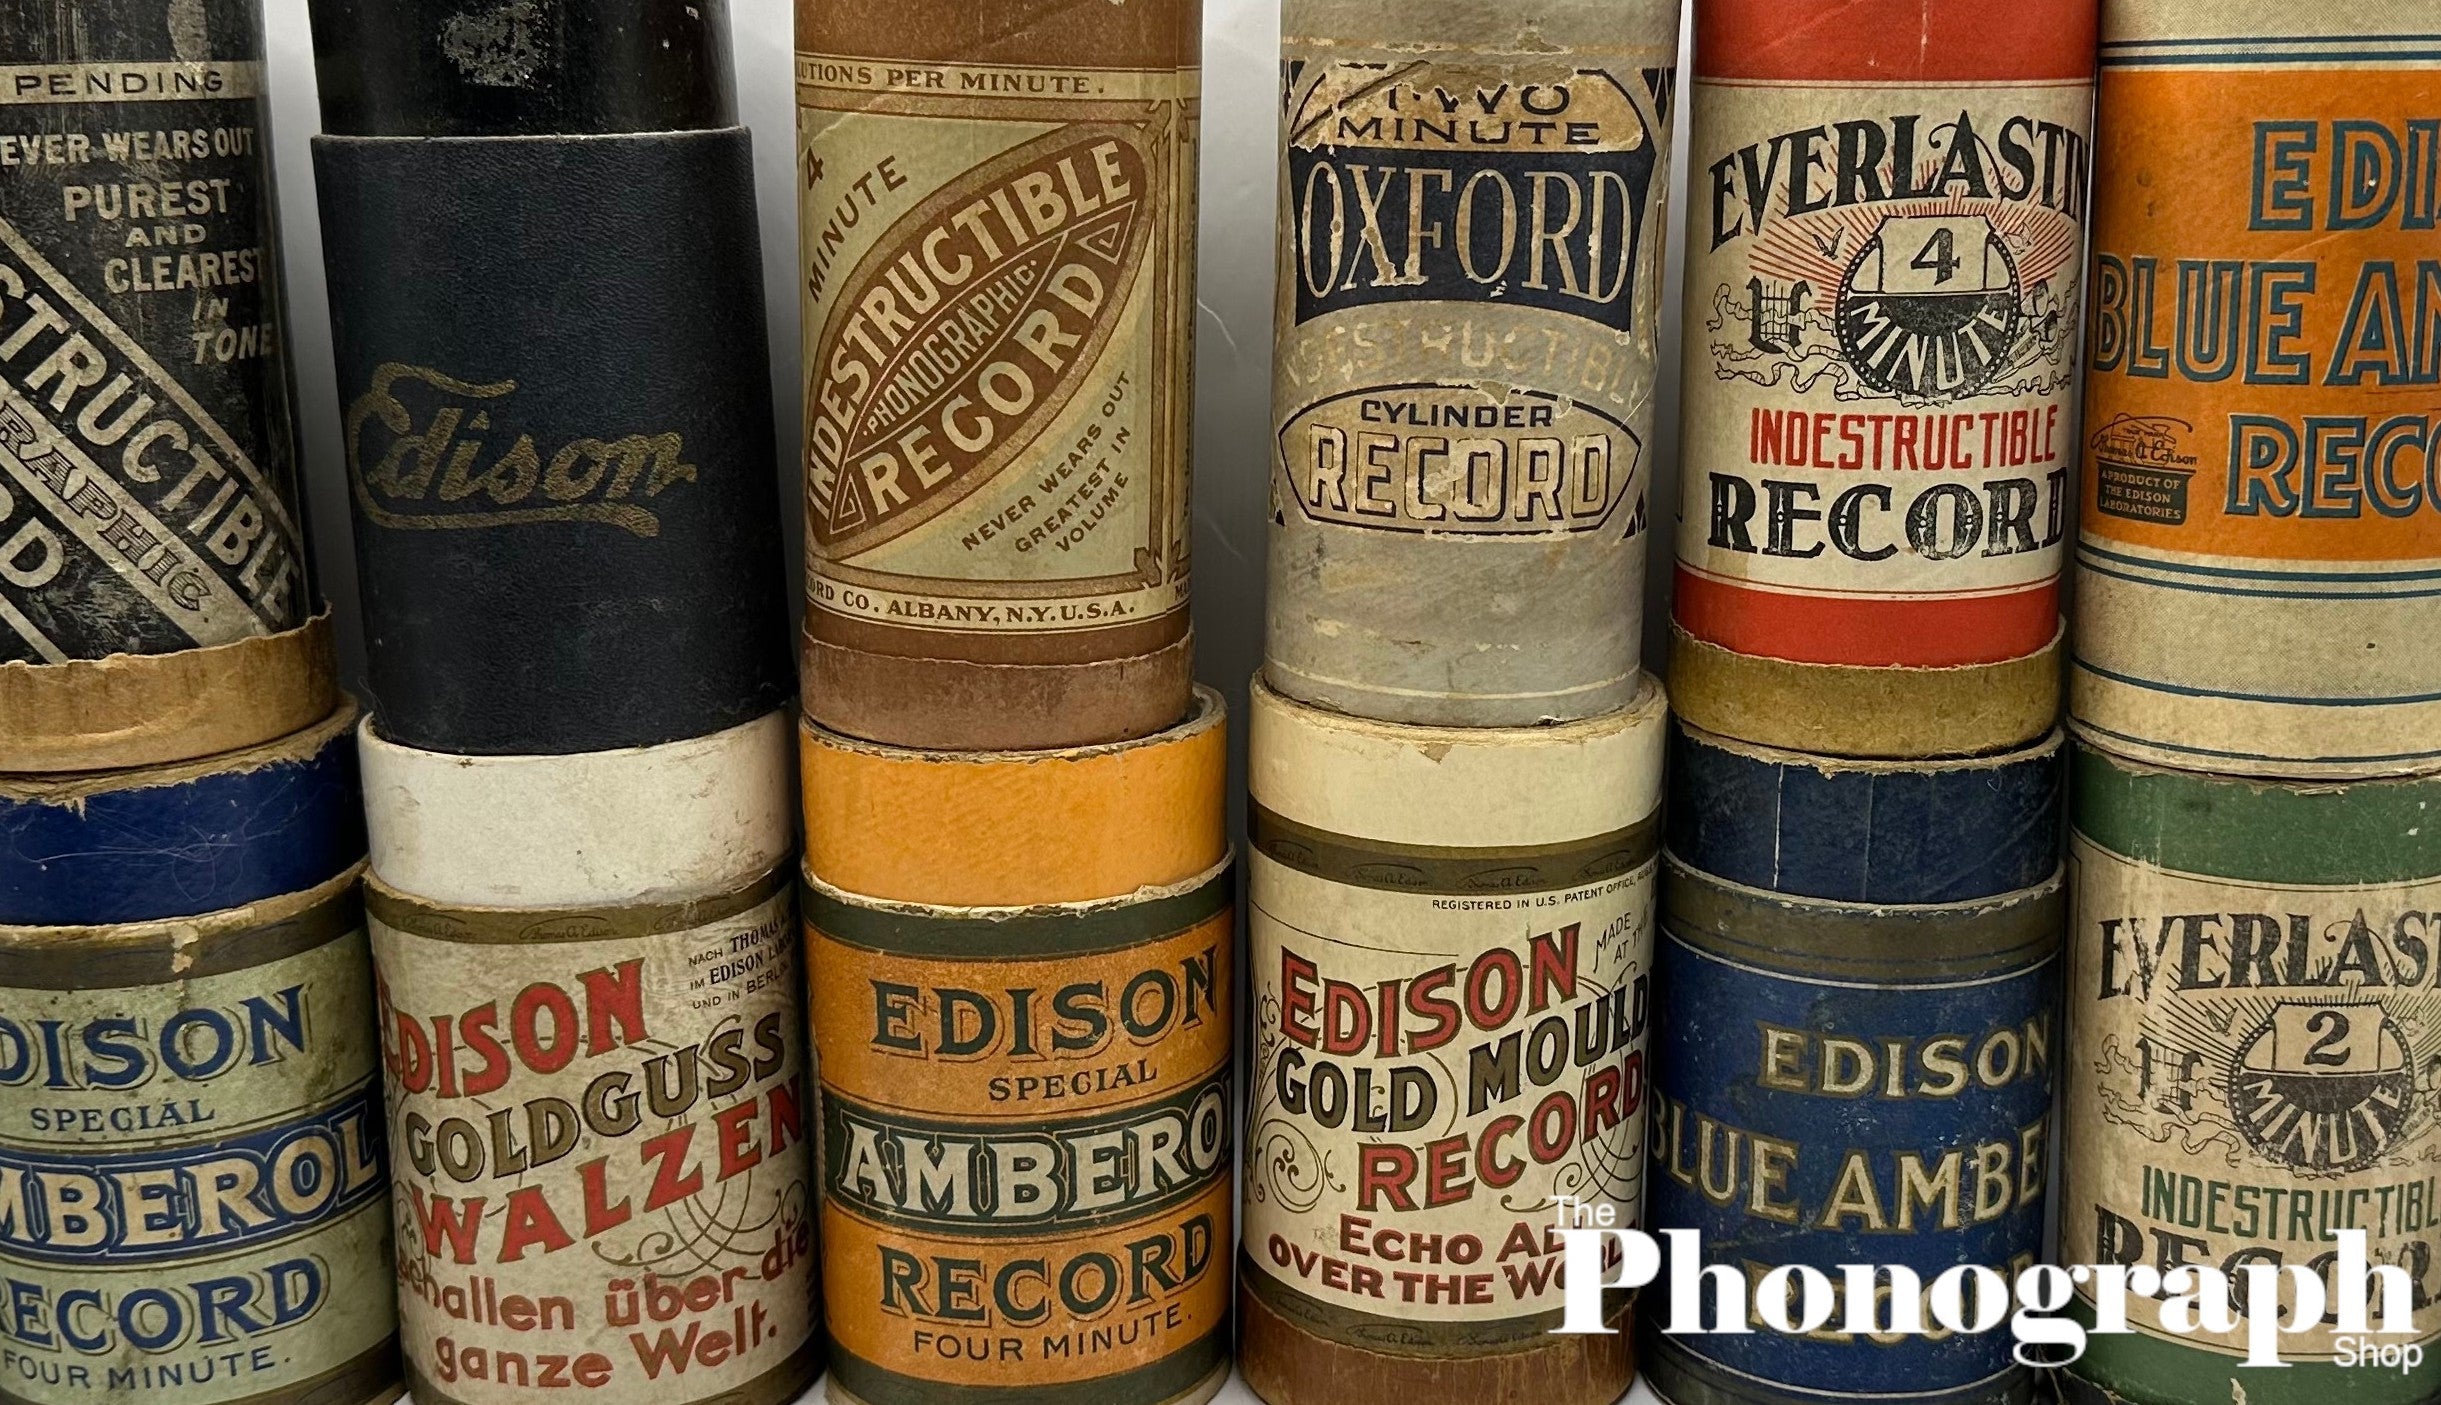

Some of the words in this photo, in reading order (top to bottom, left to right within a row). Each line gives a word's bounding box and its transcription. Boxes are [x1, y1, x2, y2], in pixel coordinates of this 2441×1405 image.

[15, 71, 223, 96] PENDING
[886, 68, 945, 89] PER
[960, 70, 1105, 95] MINUTE.
[102, 129, 209, 162] WEARS
[214, 126, 254, 157] OUT
[1337, 115, 1601, 146] MINUTE
[62, 178, 231, 222] PUREST
[806, 146, 825, 191] 4
[125, 223, 208, 248] AND
[807, 155, 909, 304] MINUTE
[1301, 159, 1633, 305] OXFORD
[1909, 227, 1960, 286] 4
[104, 247, 262, 295] CLEAREST
[193, 296, 229, 322] IN
[808, 140, 1132, 521] INDESTRUCTIBLE
[2093, 253, 2317, 385] BLUE
[193, 323, 274, 365] TONE
[1850, 300, 2008, 391] MINUTE
[861, 263, 1104, 517] RECORD
[1360, 400, 1553, 429] CYLINDER
[345, 361, 698, 538] Edison
[961, 495, 1036, 551] NEVER
[1037, 425, 1102, 494] WEARS
[1102, 370, 1132, 418] OUT
[1749, 404, 2058, 472] INDESTRUCTIBLE
[2223, 411, 2441, 519] REC
[1015, 462, 1111, 553] GREATEST
[1111, 426, 1132, 454] IN
[1308, 422, 1612, 524] RECORD
[2106, 484, 2122, 496] THE
[2125, 488, 2172, 504] EDISON
[2107, 471, 2161, 488] PRODUCT
[2163, 478, 2181, 490] OF
[1056, 473, 1130, 554] VOLUME
[1707, 466, 2068, 562] RECORD
[2100, 497, 2181, 519] LABORATORIES
[843, 590, 879, 610] CO.
[886, 600, 1001, 626] ALBANY,
[1432, 899, 1512, 911] REGISTERED
[1517, 898, 1530, 909] IN
[1535, 895, 1560, 908] U.S.
[1564, 886, 1604, 903] PATENT
[688, 948, 723, 967] NACH
[690, 978, 705, 991] IM
[709, 949, 765, 985] EDISON
[1593, 911, 1631, 974] MADE
[1613, 939, 1629, 965] AT
[692, 996, 722, 1010] UND
[727, 989, 740, 1001] IN
[869, 945, 1217, 1060] EDISON
[1279, 921, 1581, 1059] EDISON
[1275, 1045, 1438, 1133] GOLD
[1467, 974, 1649, 1118] MOULD
[1758, 1011, 2050, 1099] EDISON
[2303, 1010, 2351, 1067] 2
[988, 1058, 1158, 1101] SPECIAL
[31, 1098, 216, 1133] SPECIAL
[1356, 1050, 1643, 1213] RECORD
[2242, 1080, 2401, 1164] MINUTE
[409, 1075, 800, 1265] WALZEN
[1652, 1086, 1800, 1224] BLUE
[876, 1213, 1214, 1326] RECORD
[1268, 1232, 1386, 1300] OVER
[1393, 1270, 1495, 1305] THE
[1339, 1212, 1484, 1266] ECHO
[605, 1266, 748, 1327] über
[761, 1218, 811, 1282] die
[0, 1257, 326, 1354] ECORD
[913, 1329, 1023, 1361] FOUR
[1042, 1302, 1193, 1359] MINUTE.
[4, 1347, 91, 1389] FOUR
[108, 1344, 292, 1391] MINUTE.
[435, 1336, 615, 1388] ganze
[629, 1298, 778, 1381] Welt.
